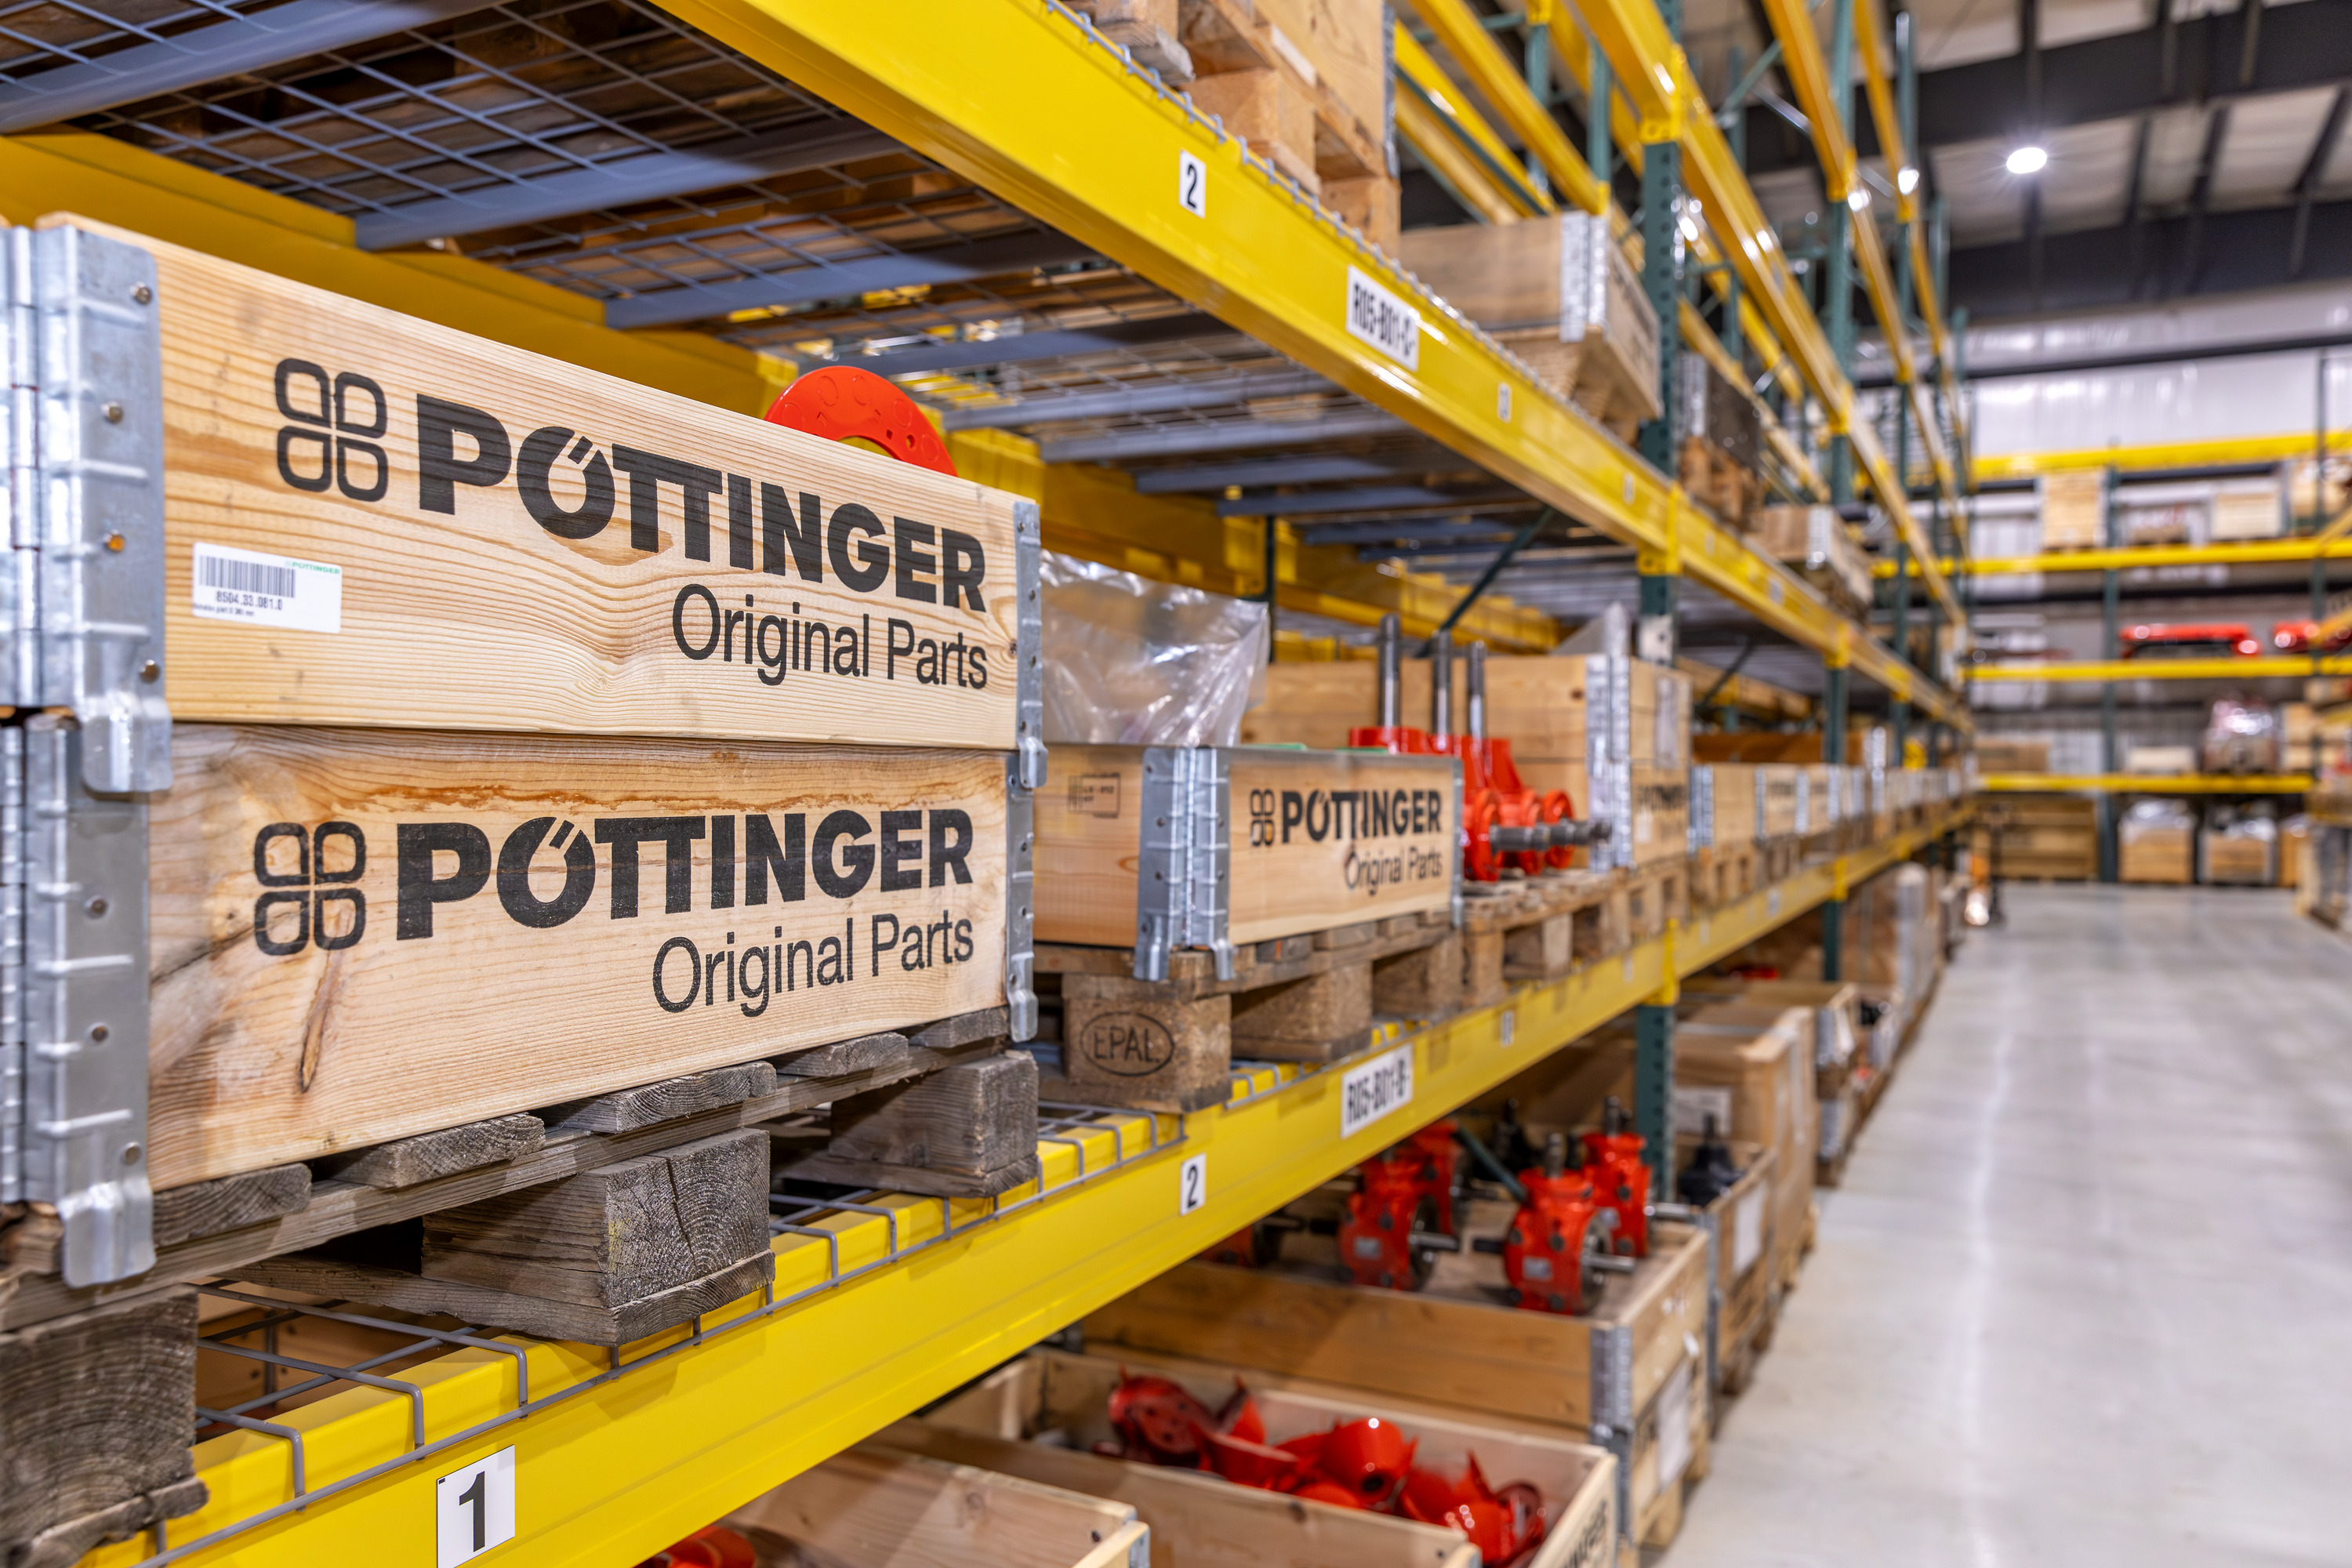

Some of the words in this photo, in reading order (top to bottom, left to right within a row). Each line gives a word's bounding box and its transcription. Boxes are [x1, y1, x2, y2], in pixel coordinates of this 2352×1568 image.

[1186, 162, 1198, 209] 2
[416, 394, 987, 612] PÖTTINGER
[672, 583, 870, 686] Original
[887, 617, 988, 689] Parts
[1281, 789, 1442, 844] PÖTTINGER
[396, 809, 974, 941] PÖTTINGER
[1345, 848, 1404, 897] Original
[1409, 846, 1443, 880] Parts
[652, 917, 854, 1018] Original
[872, 909, 975, 977] Parts
[1093, 1025, 1160, 1063] EPAL
[1186, 1164, 1198, 1208] 2
[459, 1470, 486, 1553] 1
